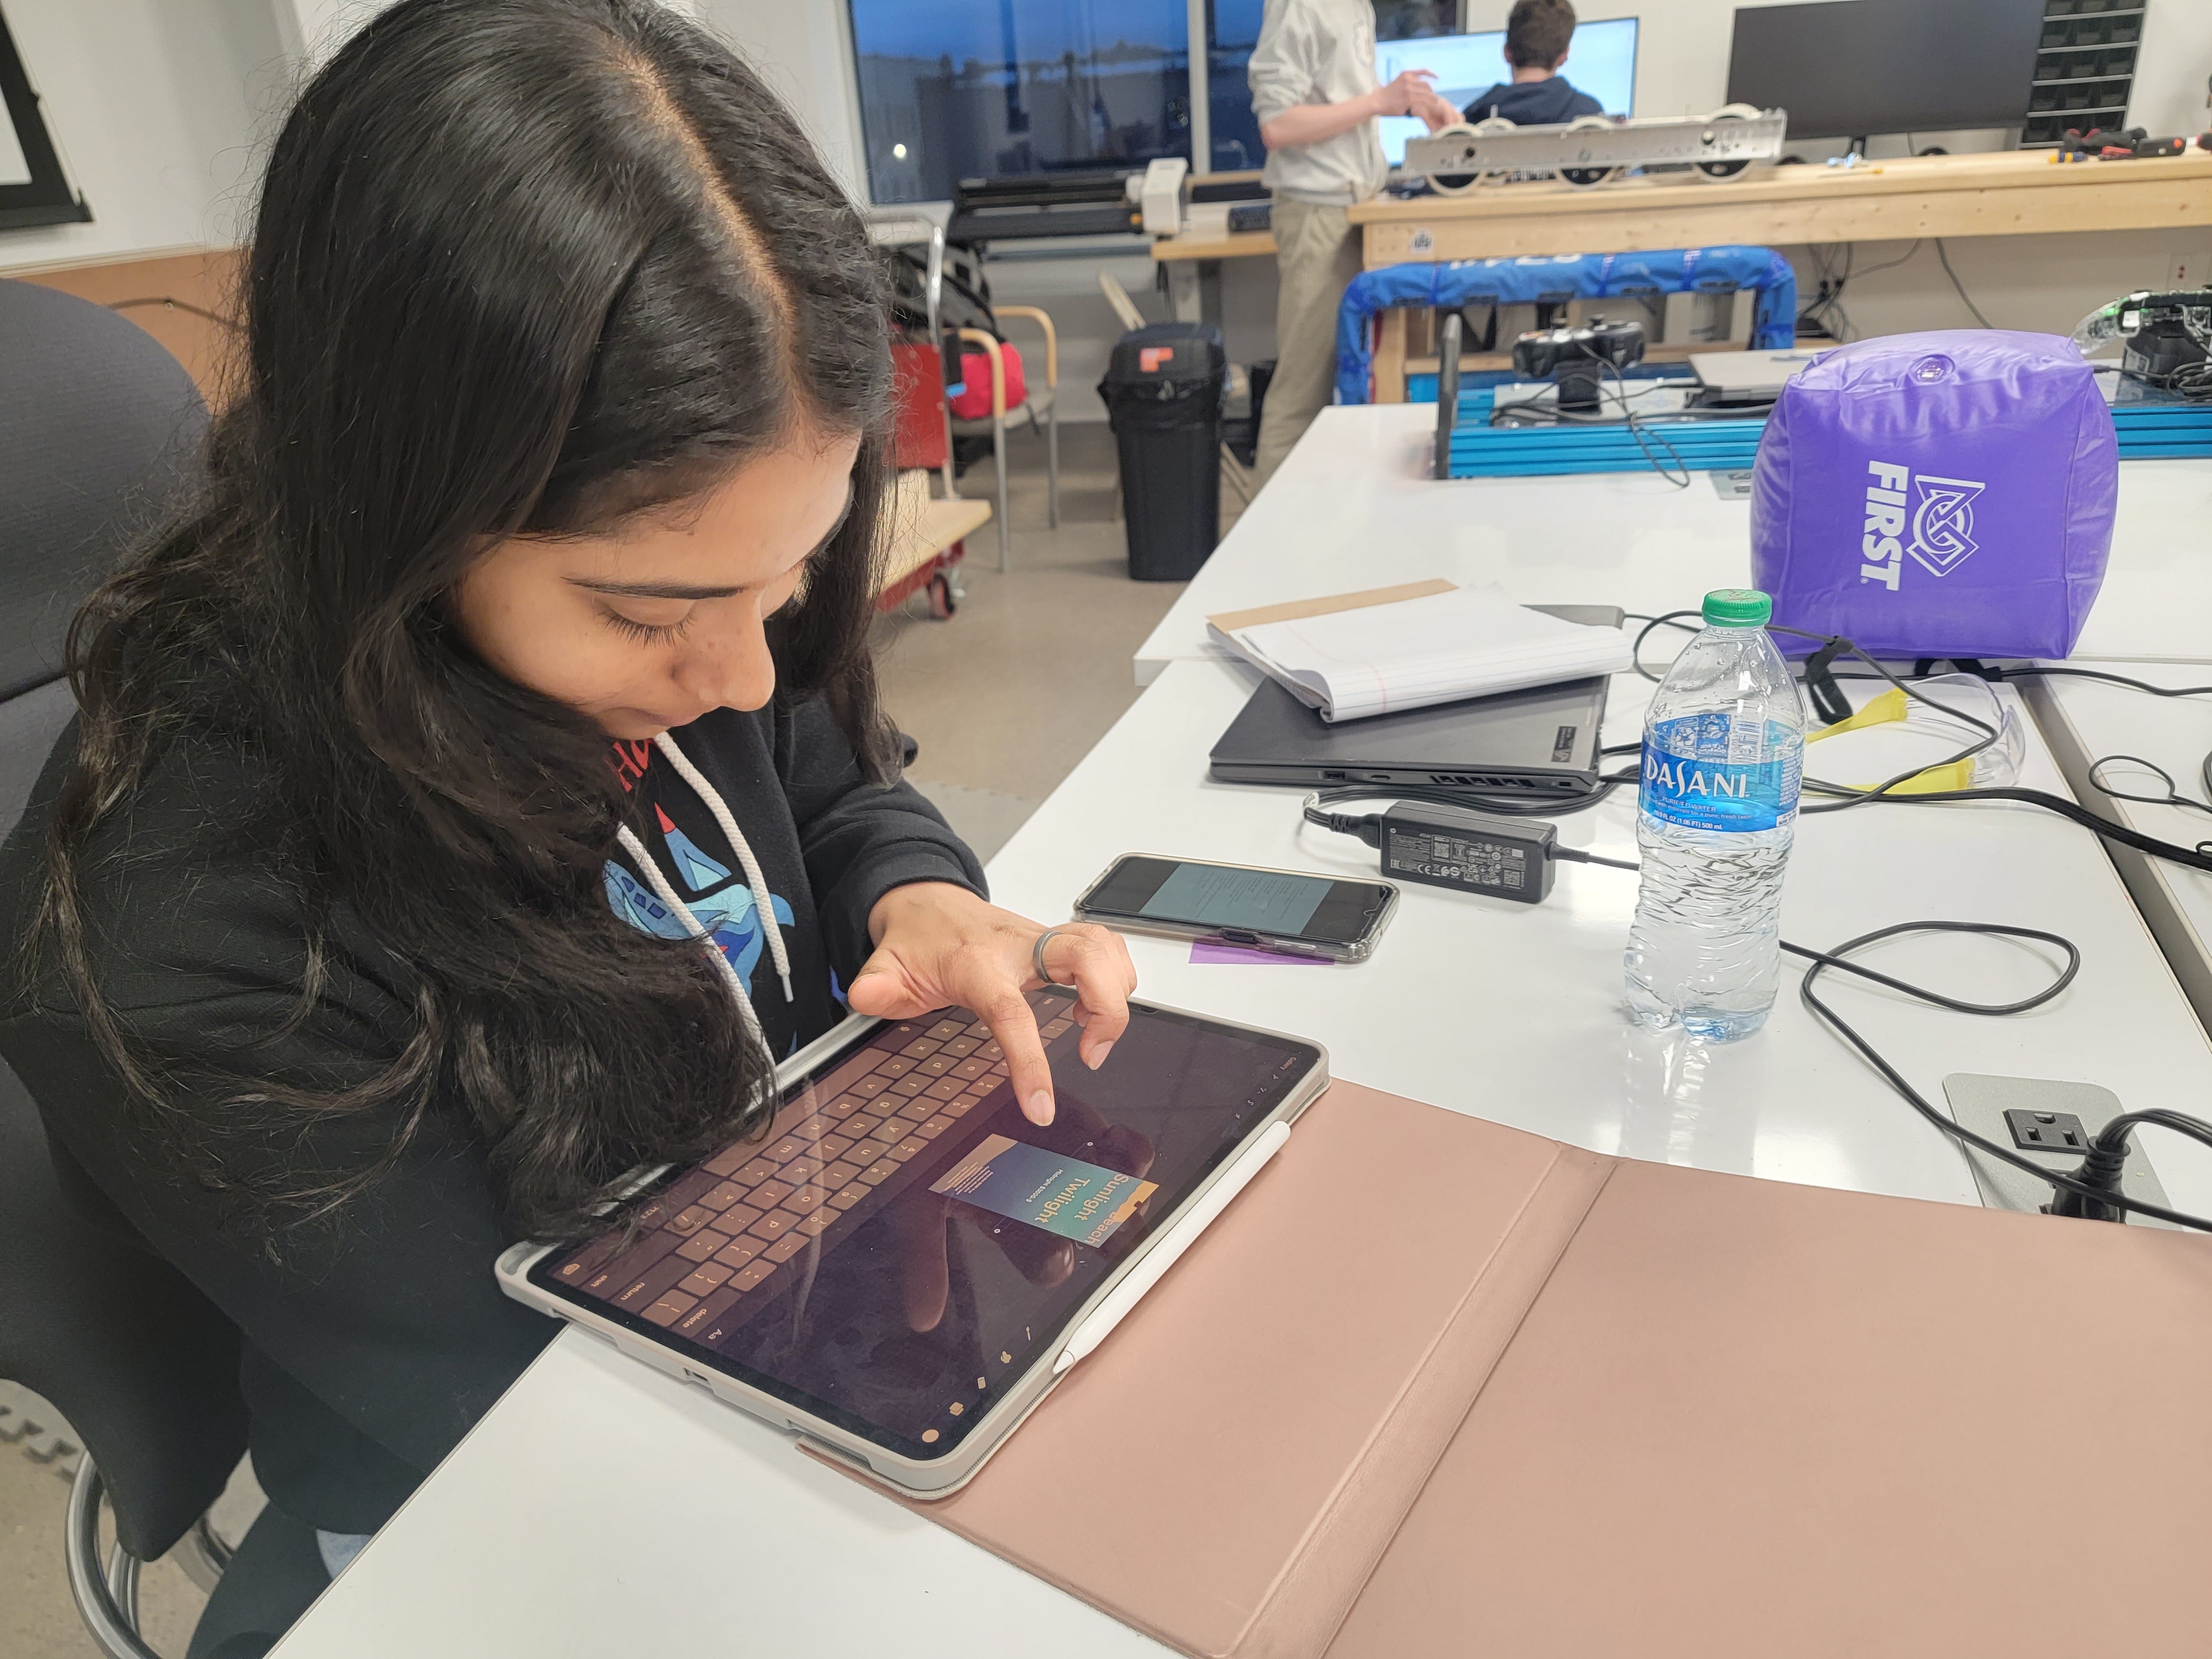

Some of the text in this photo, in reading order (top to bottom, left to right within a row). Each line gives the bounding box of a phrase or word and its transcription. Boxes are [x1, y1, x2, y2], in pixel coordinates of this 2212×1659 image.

[1861, 460, 1909, 592] FIRST
[1646, 754, 1746, 798] DASANI
[1662, 796, 1689, 808] PURIFIED
[1691, 803, 1716, 812] WATER
[1667, 805, 1690, 814] minerals
[1043, 1168, 1064, 1186] Midnight
[1034, 1178, 1091, 1223] Twilight
[1074, 1174, 1129, 1221] Sunlight
[591, 1275, 607, 1287] shift
[620, 1282, 645, 1300] return
[683, 1309, 707, 1328] delete
[708, 1328, 722, 1339] Aa
